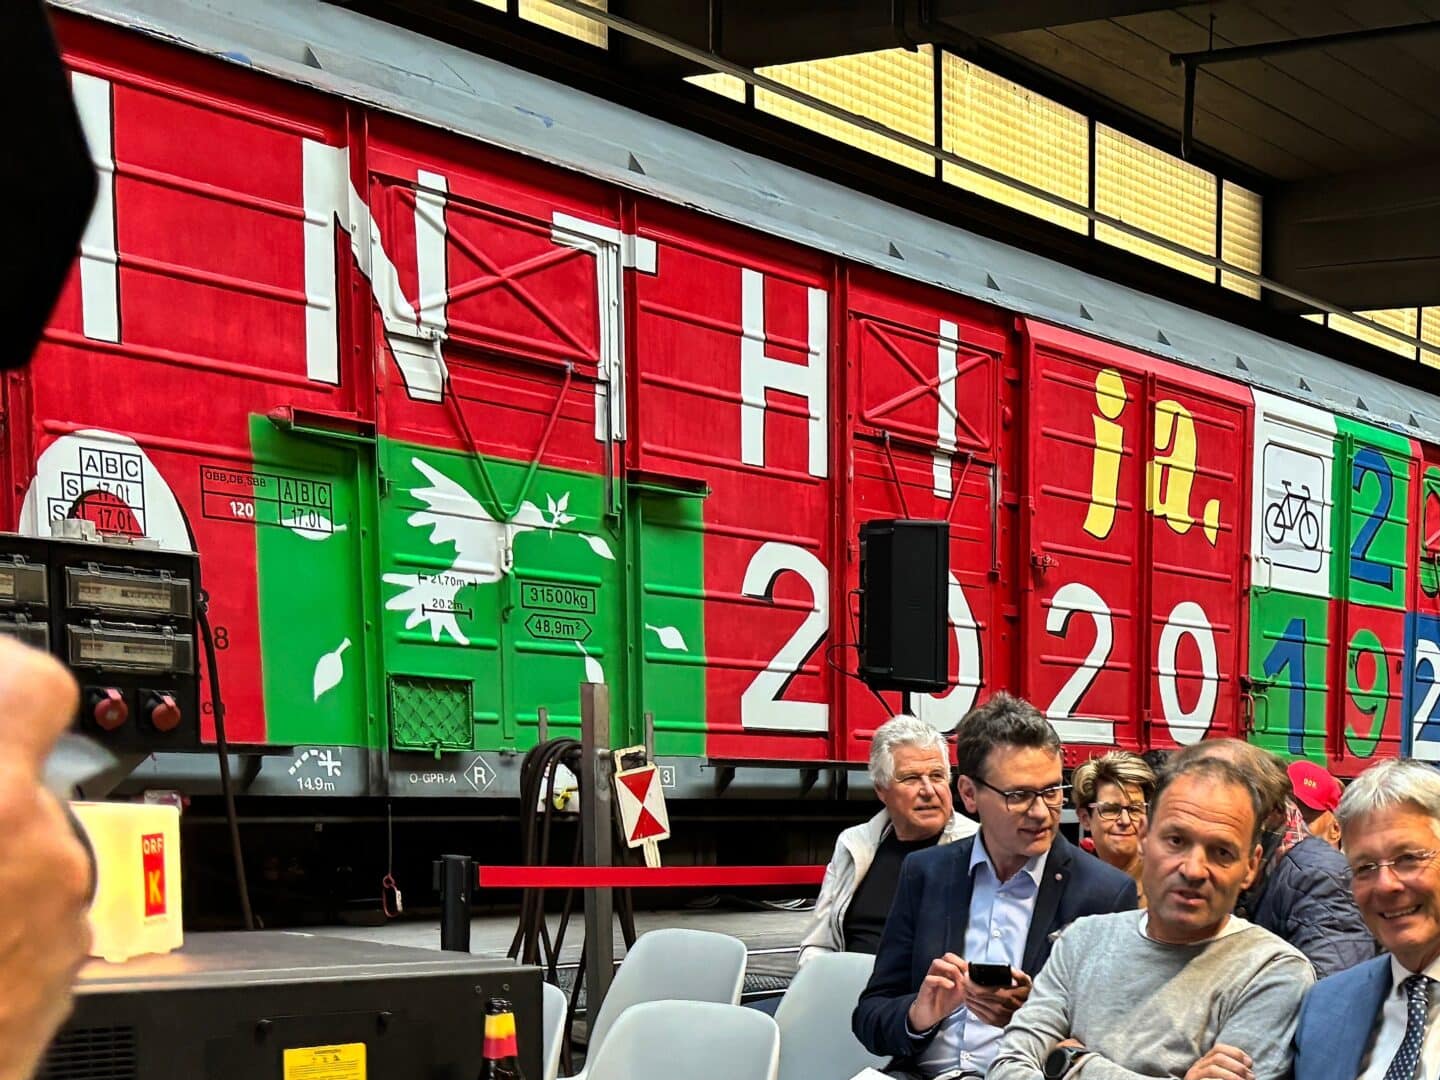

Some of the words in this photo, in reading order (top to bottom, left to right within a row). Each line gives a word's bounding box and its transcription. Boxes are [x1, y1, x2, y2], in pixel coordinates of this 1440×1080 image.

[230, 501, 254, 518] 120
[530, 587, 589, 609] 31500kg
[473, 766, 486, 785] R
[662, 769, 671, 784] 3
[297, 777, 335, 792] 14.9m
[143, 838, 163, 855] ORF
[148, 869, 162, 904] K
